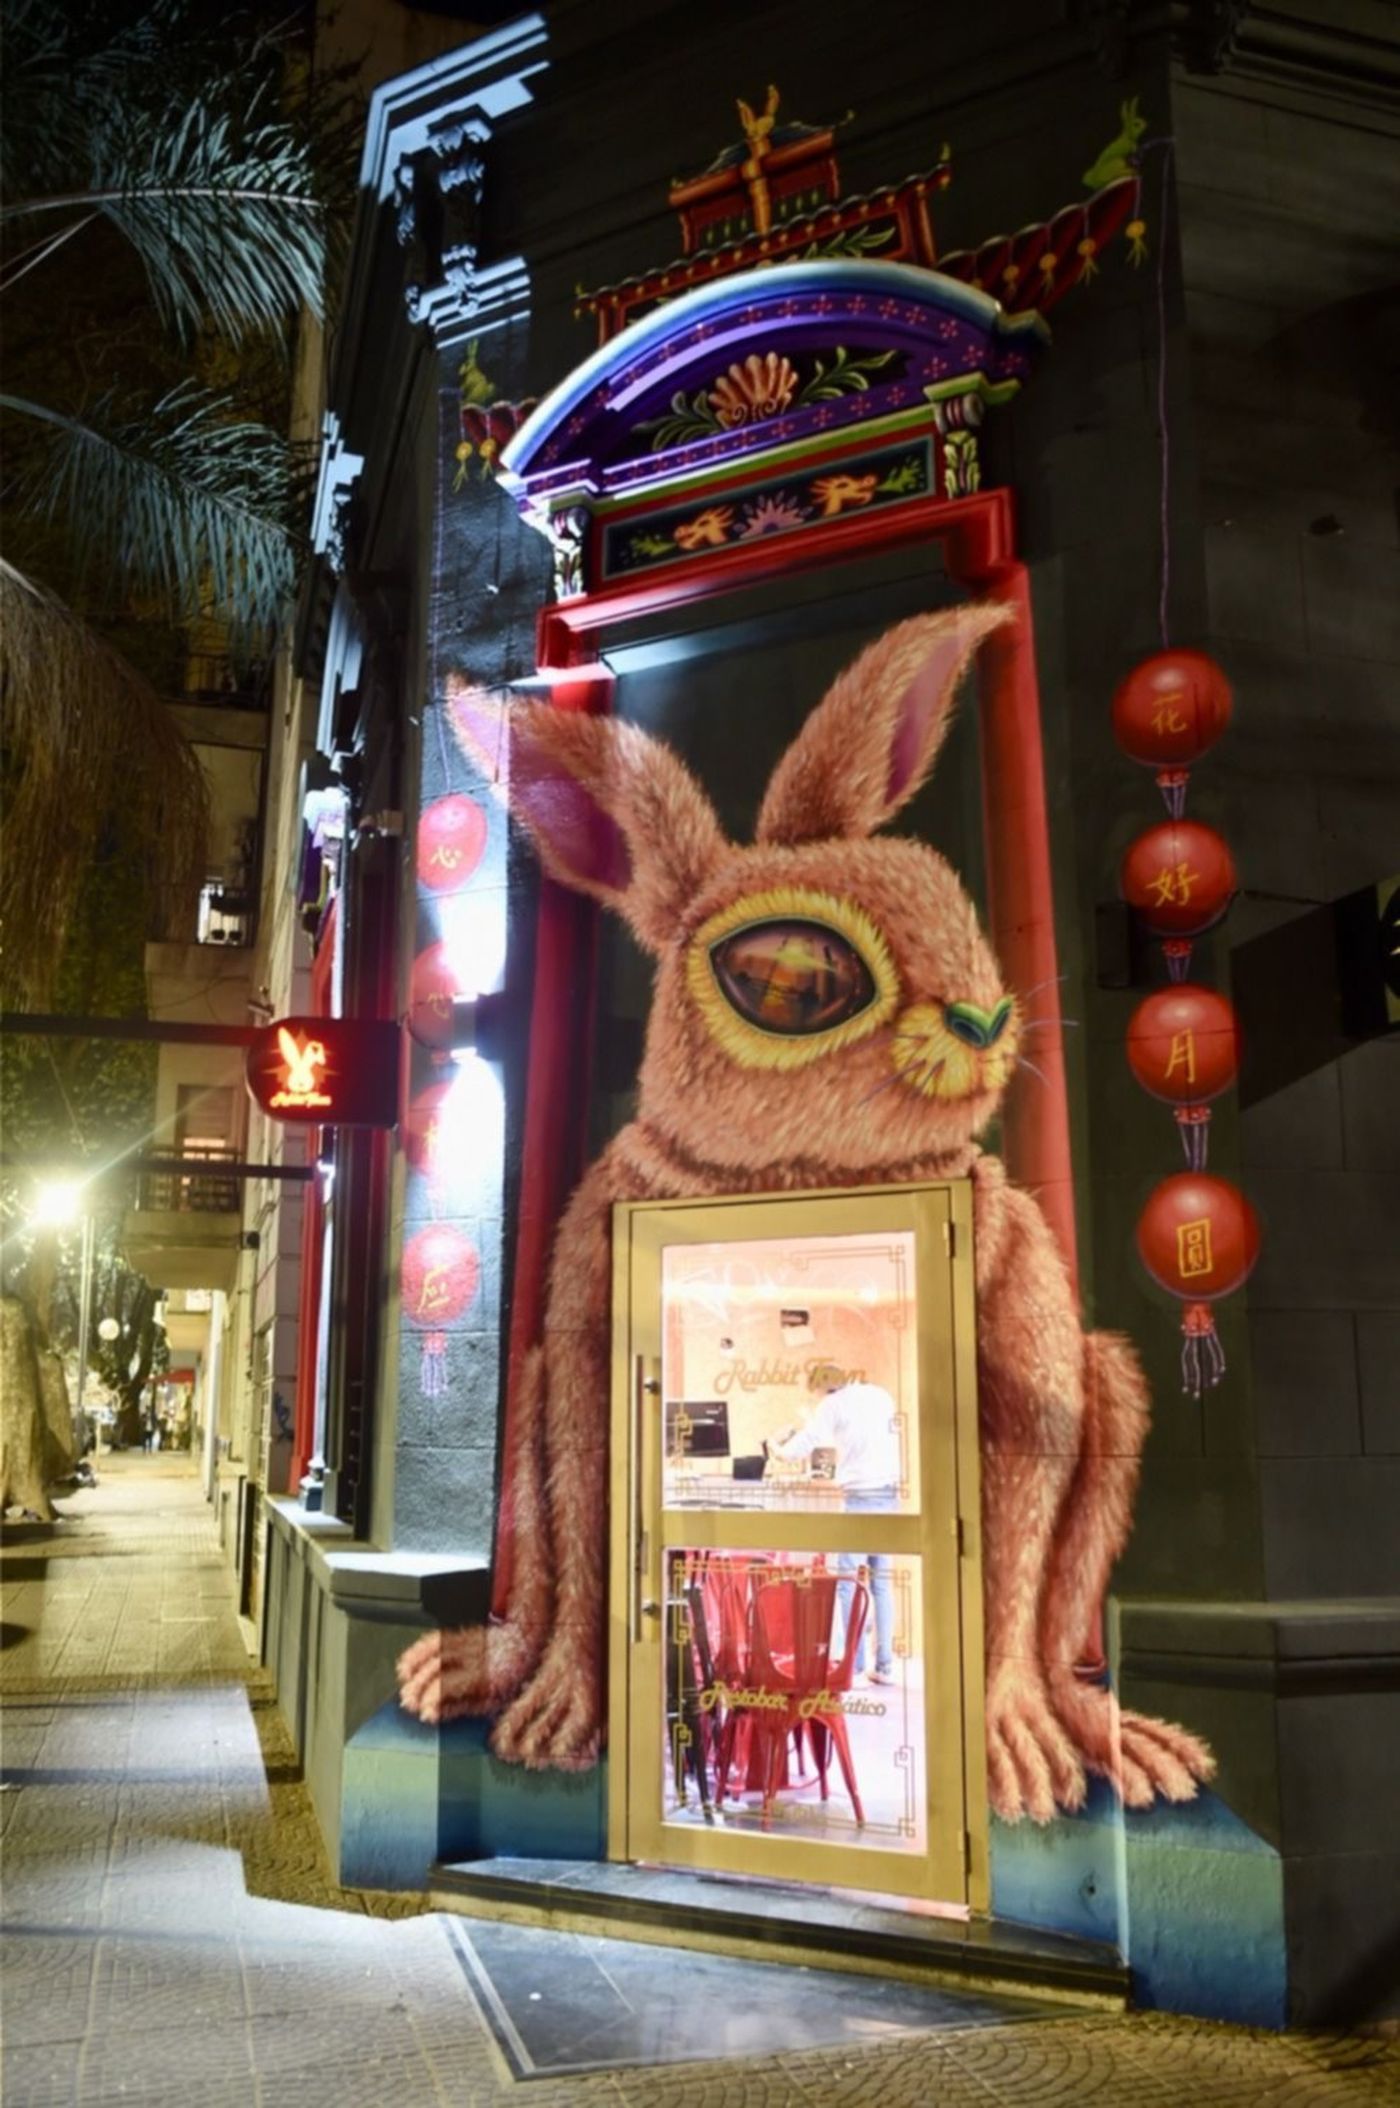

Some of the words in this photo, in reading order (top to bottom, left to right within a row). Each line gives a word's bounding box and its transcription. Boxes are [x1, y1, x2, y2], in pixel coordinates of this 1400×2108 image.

[1151, 694, 1187, 735] 花
[1145, 863, 1200, 908] 好
[1165, 1028, 1196, 1083] 月
[714, 1358, 799, 1394] Rabbit
